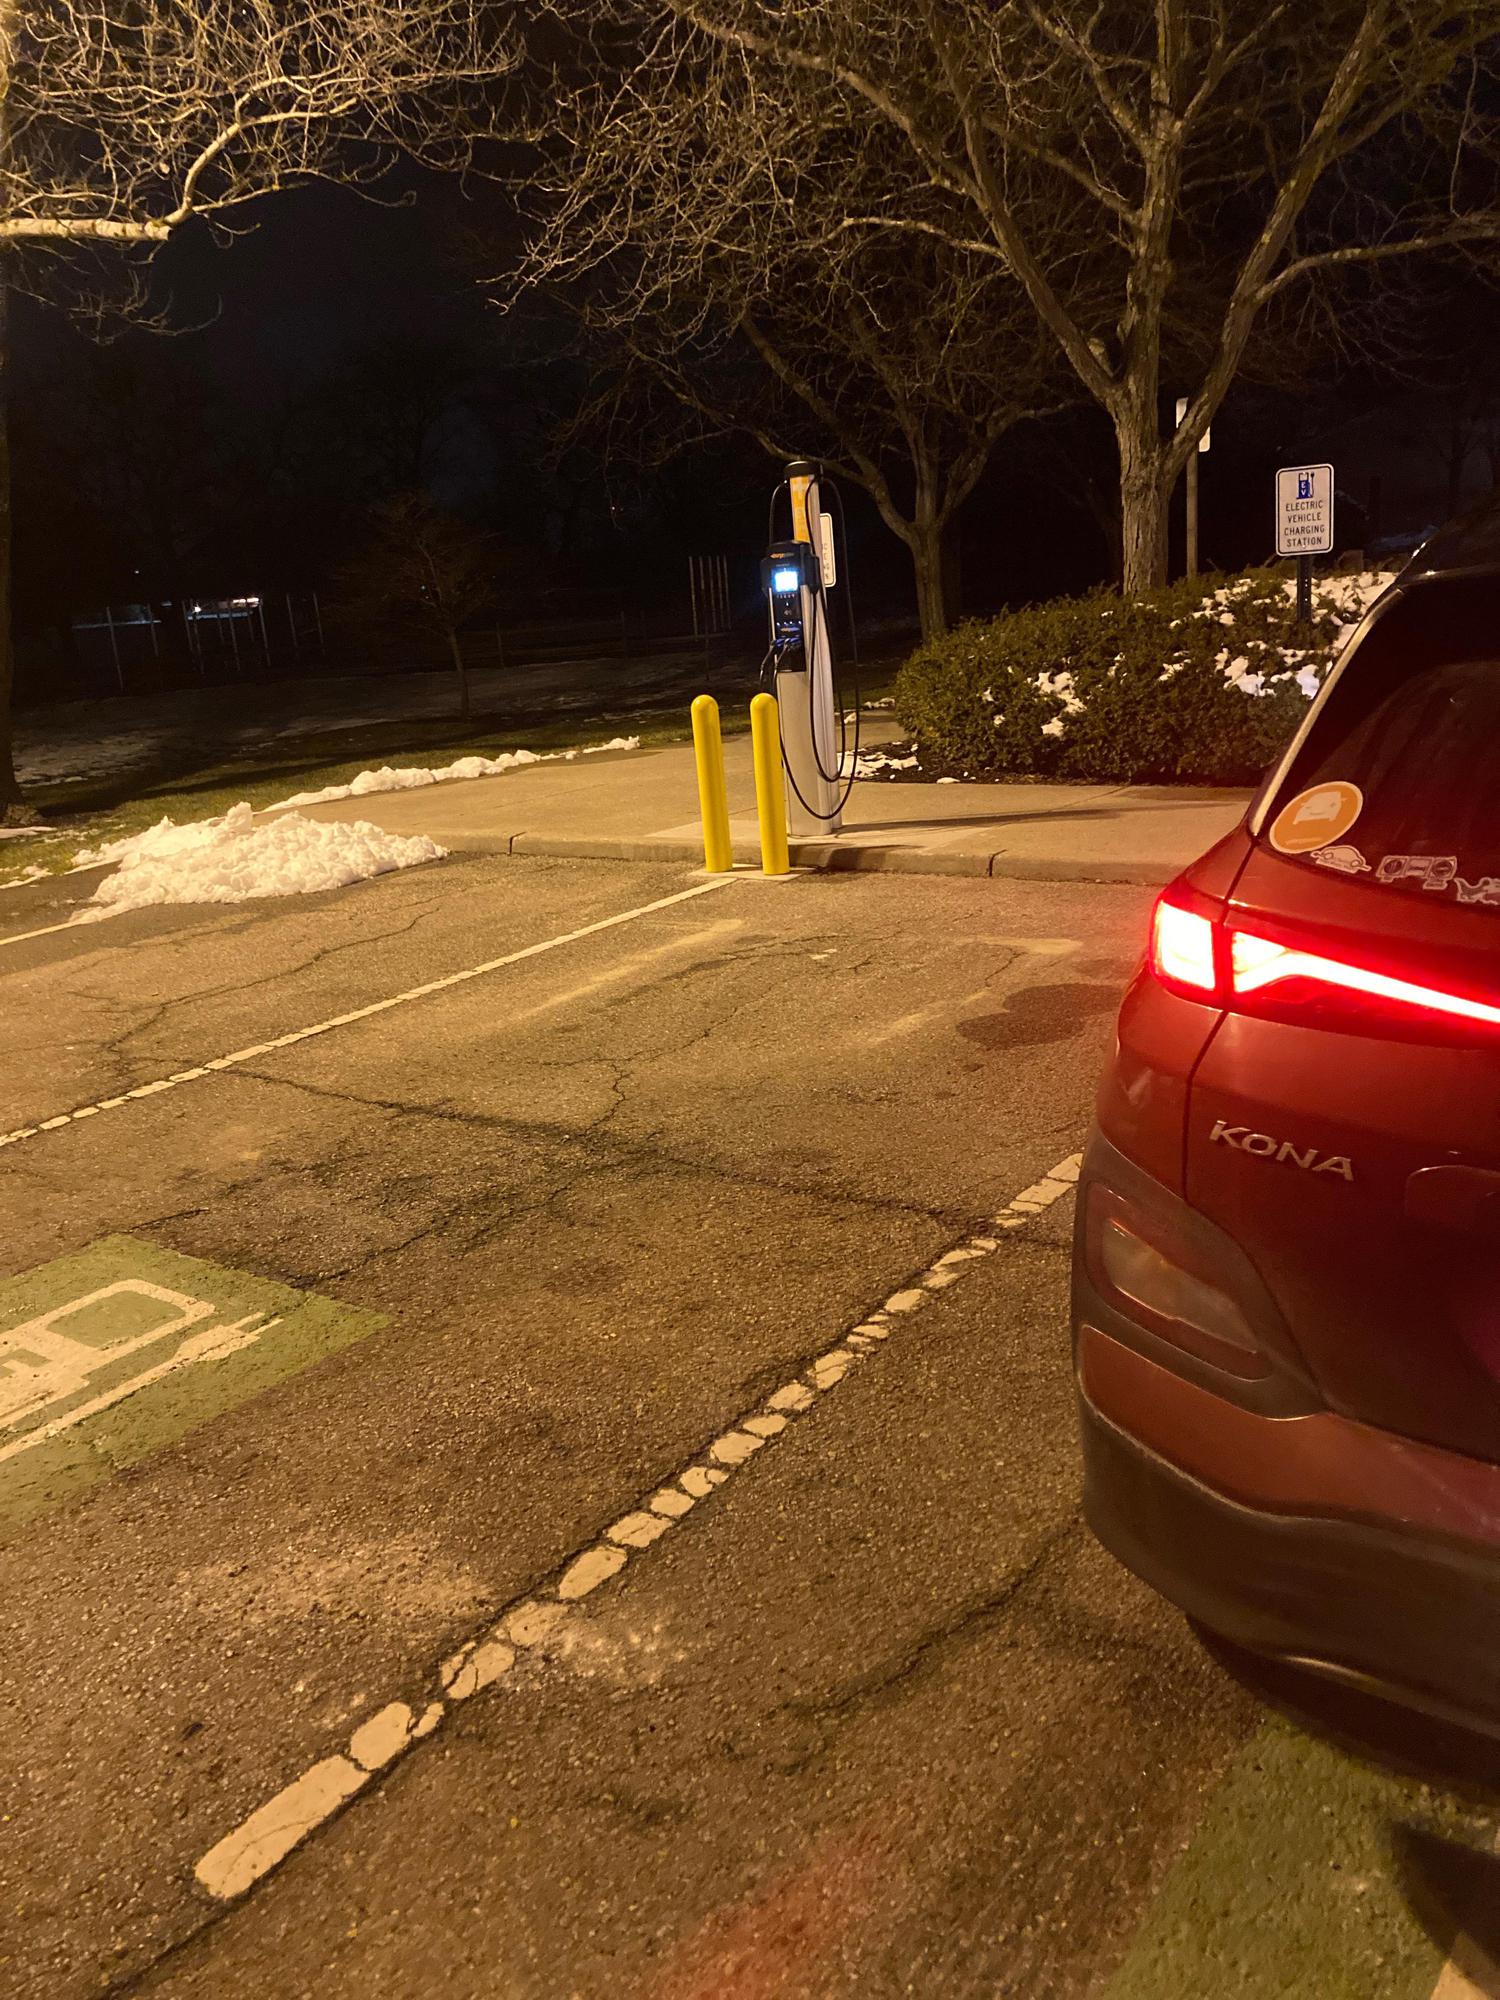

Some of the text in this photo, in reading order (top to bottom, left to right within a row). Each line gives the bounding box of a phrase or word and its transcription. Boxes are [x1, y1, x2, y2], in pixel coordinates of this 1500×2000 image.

[1285, 500, 1324, 512] ELECTRIC
[1287, 512, 1322, 523] VEHICLE
[1284, 524, 1325, 536] CHARGING
[1286, 537, 1322, 547] STATION
[1209, 1120, 1354, 1181] KONA
